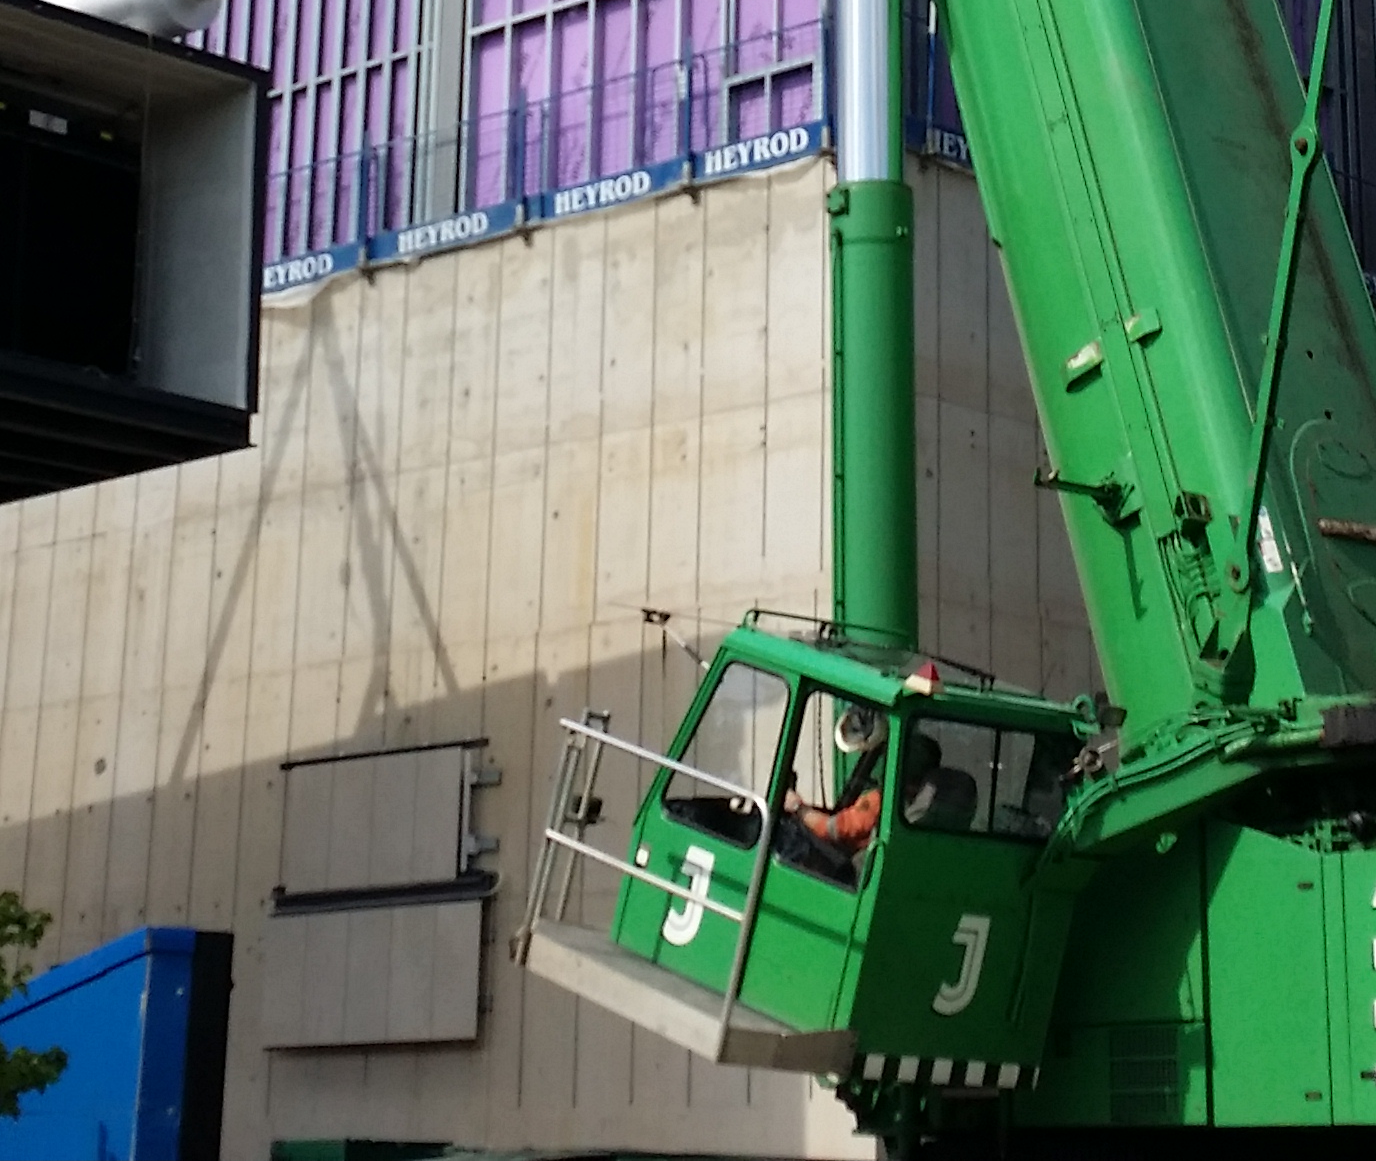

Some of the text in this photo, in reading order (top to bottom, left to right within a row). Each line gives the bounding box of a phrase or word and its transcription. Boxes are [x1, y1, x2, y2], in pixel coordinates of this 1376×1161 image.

[704, 127, 809, 175] HEYROD
[926, 127, 968, 160] HEY
[554, 171, 651, 215] HEYROD
[398, 211, 489, 253] HEYROD
[262, 253, 334, 288] EYROD
[932, 914, 991, 1016] J
